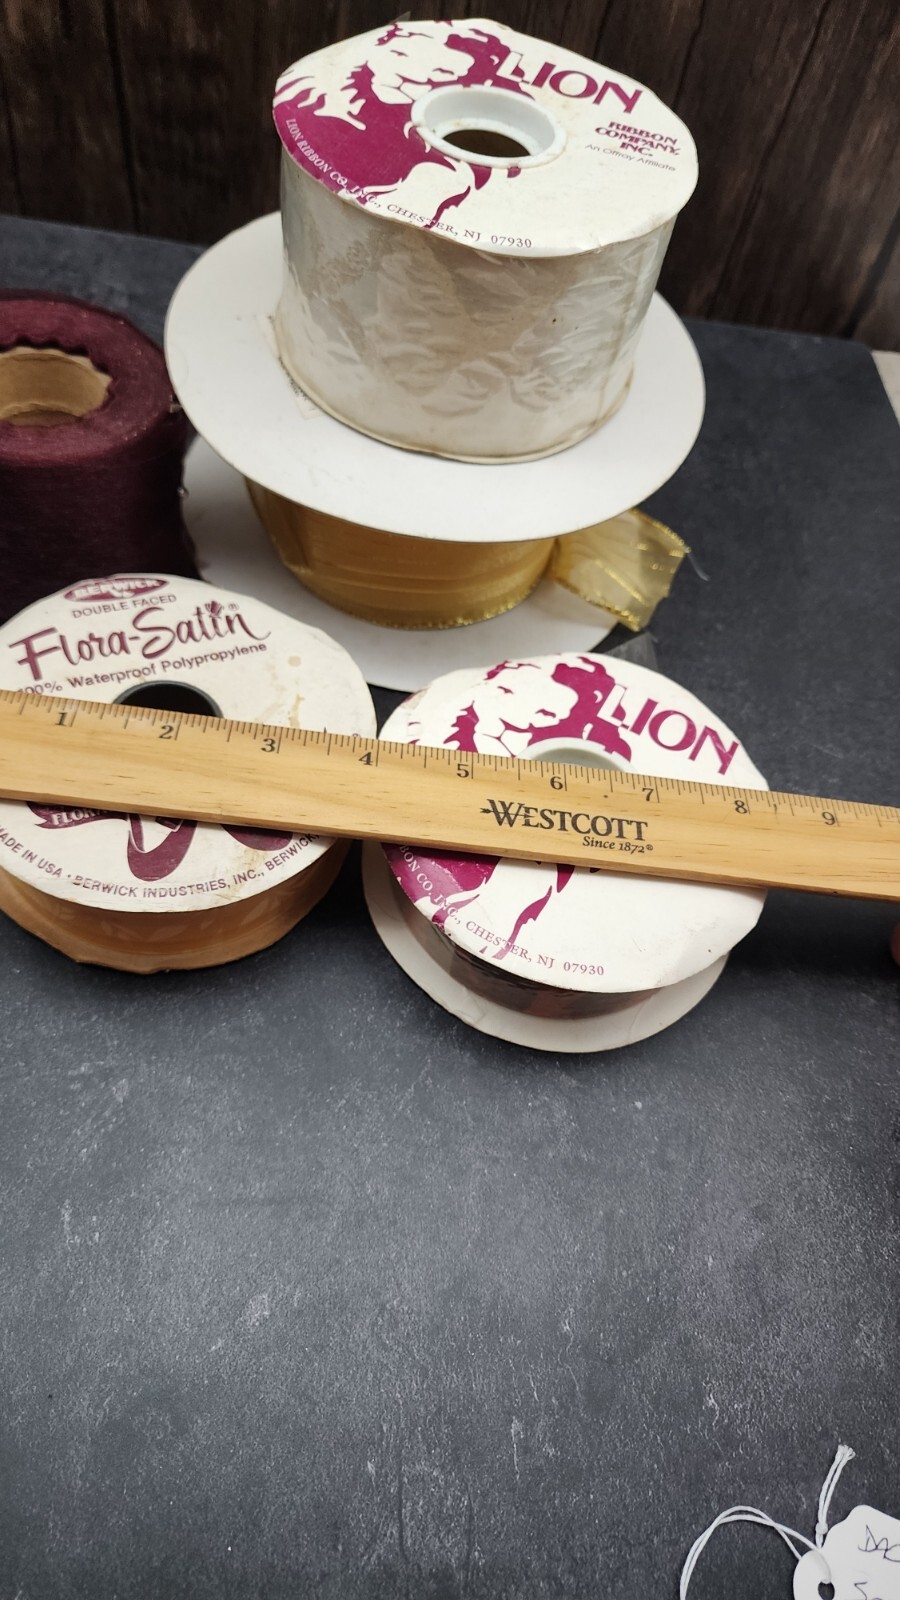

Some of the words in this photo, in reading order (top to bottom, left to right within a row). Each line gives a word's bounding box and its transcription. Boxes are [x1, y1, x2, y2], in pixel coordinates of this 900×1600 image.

[496, 50, 643, 114] LION
[585, 144, 600, 153] An
[608, 121, 678, 146] RIBBON
[619, 141, 654, 157] INC.
[286, 118, 304, 142] LION
[296, 140, 332, 173] RIBBON
[386, 203, 459, 236] CHESTER,
[463, 229, 482, 242] NJ
[490, 235, 533, 249] 07930
[71, 601, 129, 619] DOUBLE
[132, 594, 177, 609] FACED
[73, 578, 162, 600] BERWICK
[67, 663, 157, 689] Waterproof
[160, 643, 268, 673] Polypropylene
[597, 683, 739, 776] LION
[54, 711, 67, 727] 1
[158, 724, 175, 740] 2
[261, 738, 277, 753] 3
[358, 751, 374, 766] 4
[456, 763, 470, 778] 5
[550, 776, 563, 790] 6
[642, 787, 654, 802] 7
[734, 800, 748, 814] 8
[821, 811, 836, 826] 9
[480, 798, 649, 842] WESTCOTT
[582, 836, 616, 850] Since
[21, 849, 38, 864] IN
[37, 858, 63, 878] USA
[72, 874, 139, 898] BERWICK
[142, 879, 231, 898] INDUSTRIES,
[233, 869, 265, 885] INC.,
[416, 873, 433, 896] CO.
[433, 894, 461, 925] INC.,
[465, 920, 532, 963] CHESTER,
[537, 954, 556, 969] NJ
[563, 961, 605, 976] 07930
